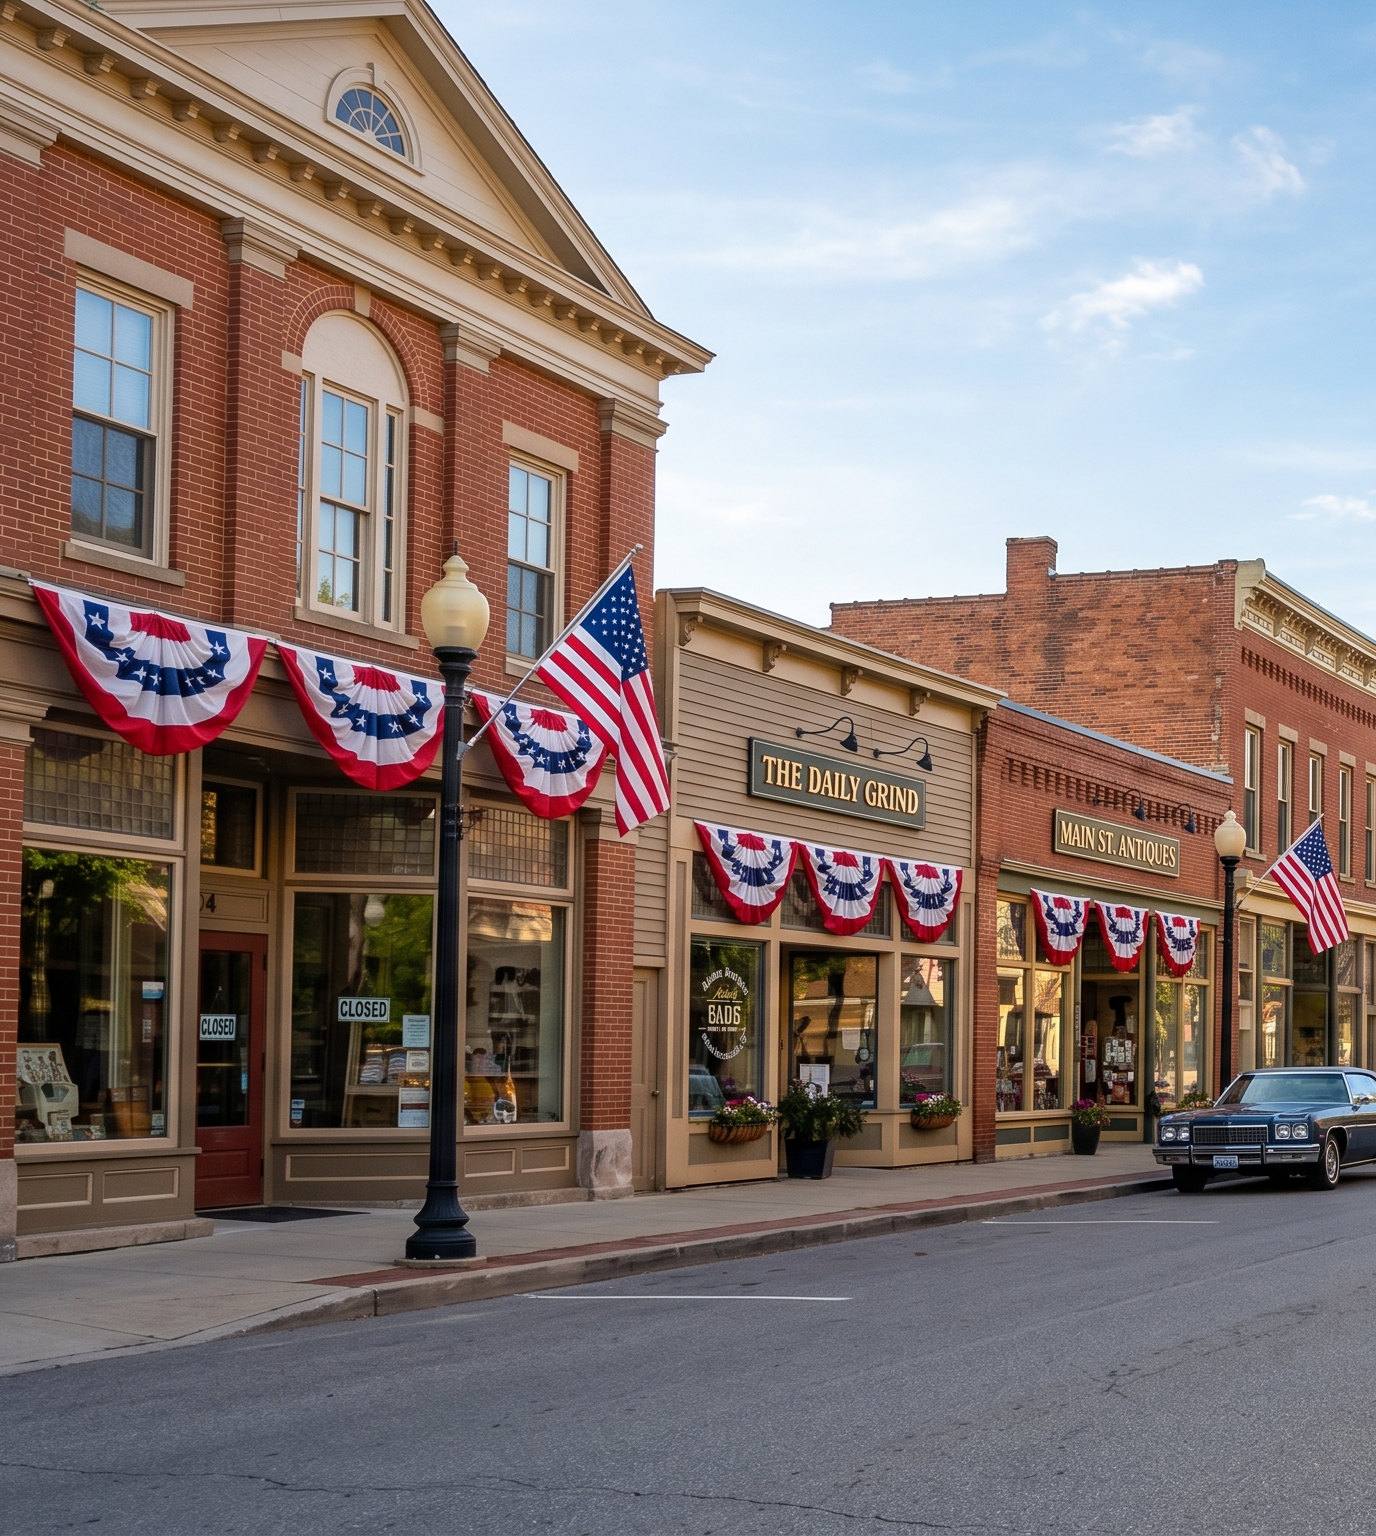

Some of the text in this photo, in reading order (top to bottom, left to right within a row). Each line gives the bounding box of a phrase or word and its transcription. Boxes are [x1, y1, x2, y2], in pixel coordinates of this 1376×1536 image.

[762, 755, 919, 815] THE DAILY GRIND
[1060, 820, 1176, 868] MAIN ST. ANTIQUES
[340, 1000, 387, 1018] CLOSED
[201, 1017, 234, 1036] CLOSED
